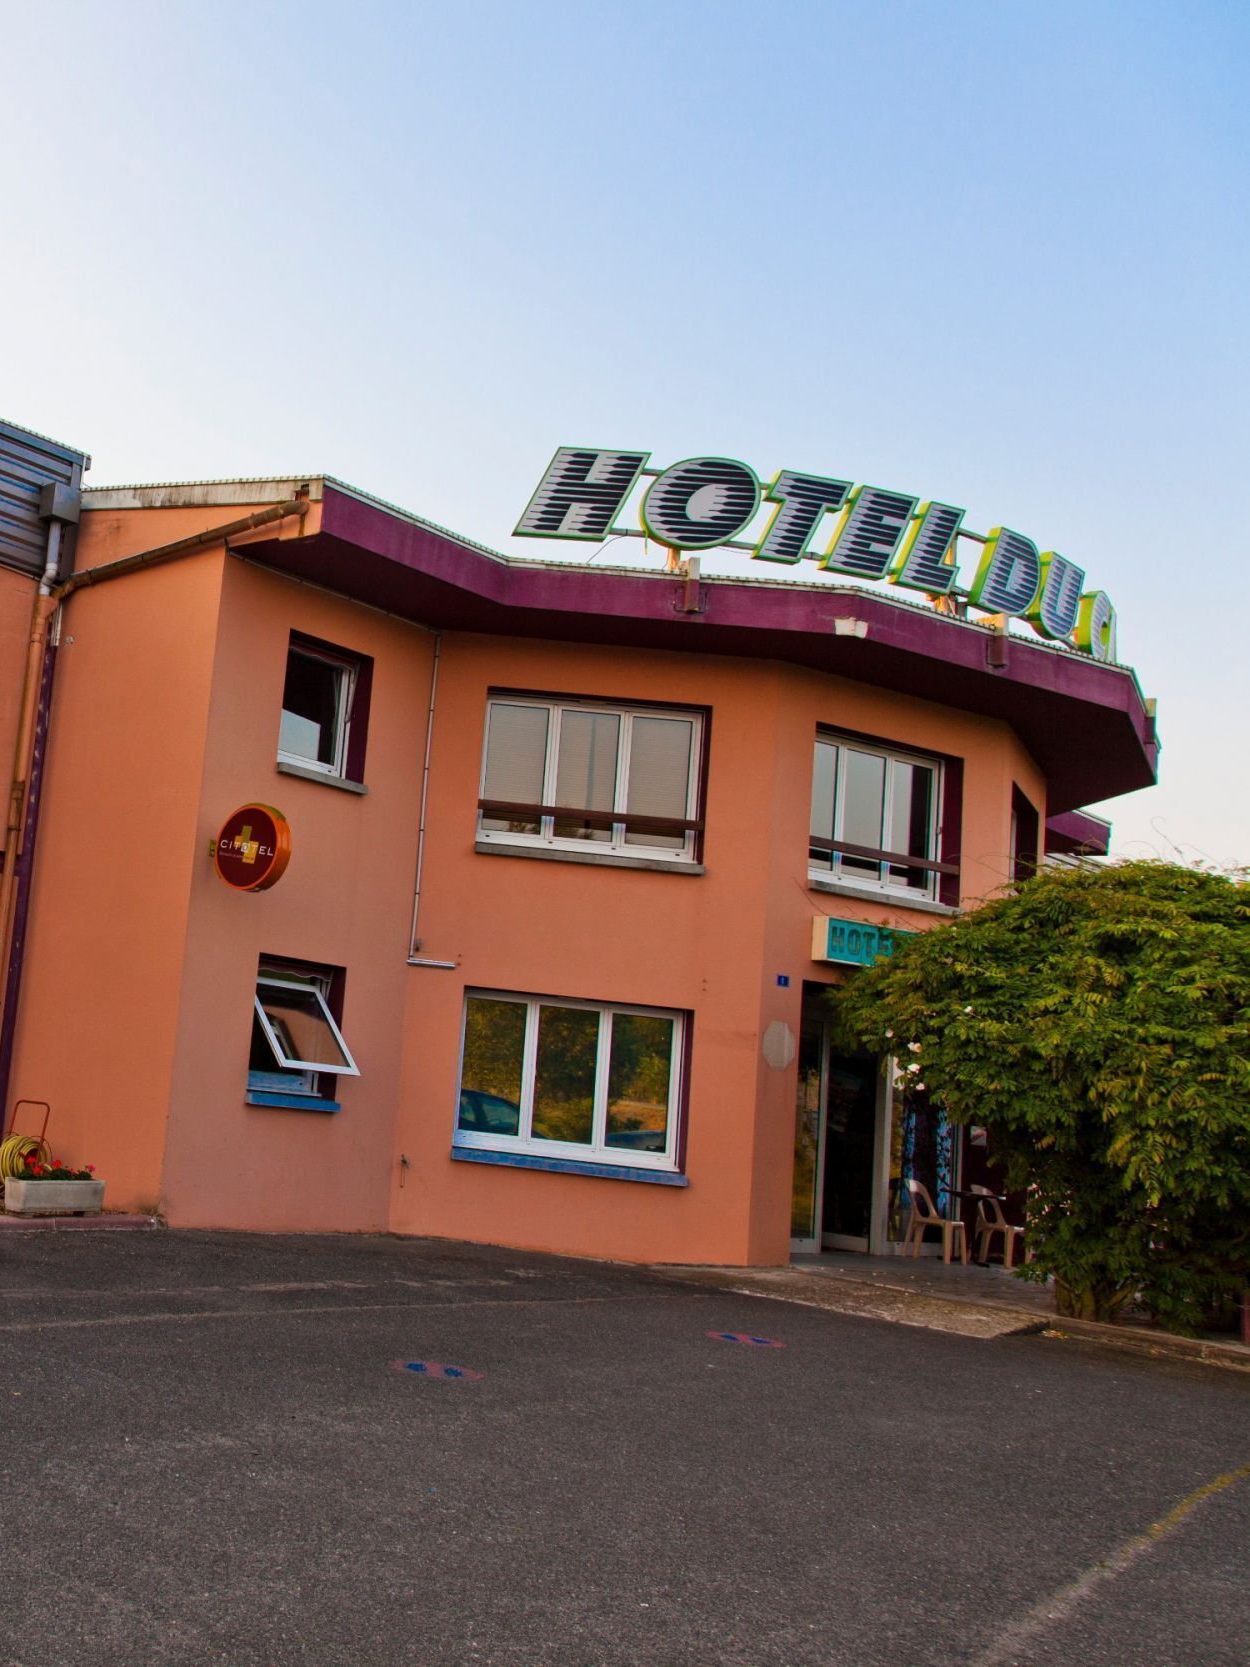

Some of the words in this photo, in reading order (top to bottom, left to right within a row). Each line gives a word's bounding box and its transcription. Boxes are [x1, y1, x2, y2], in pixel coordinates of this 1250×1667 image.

[512, 446, 966, 596] HOTEL
[968, 526, 1085, 641] DU
[220, 839, 274, 856] CITOTEL
[831, 926, 894, 959] HOTE
